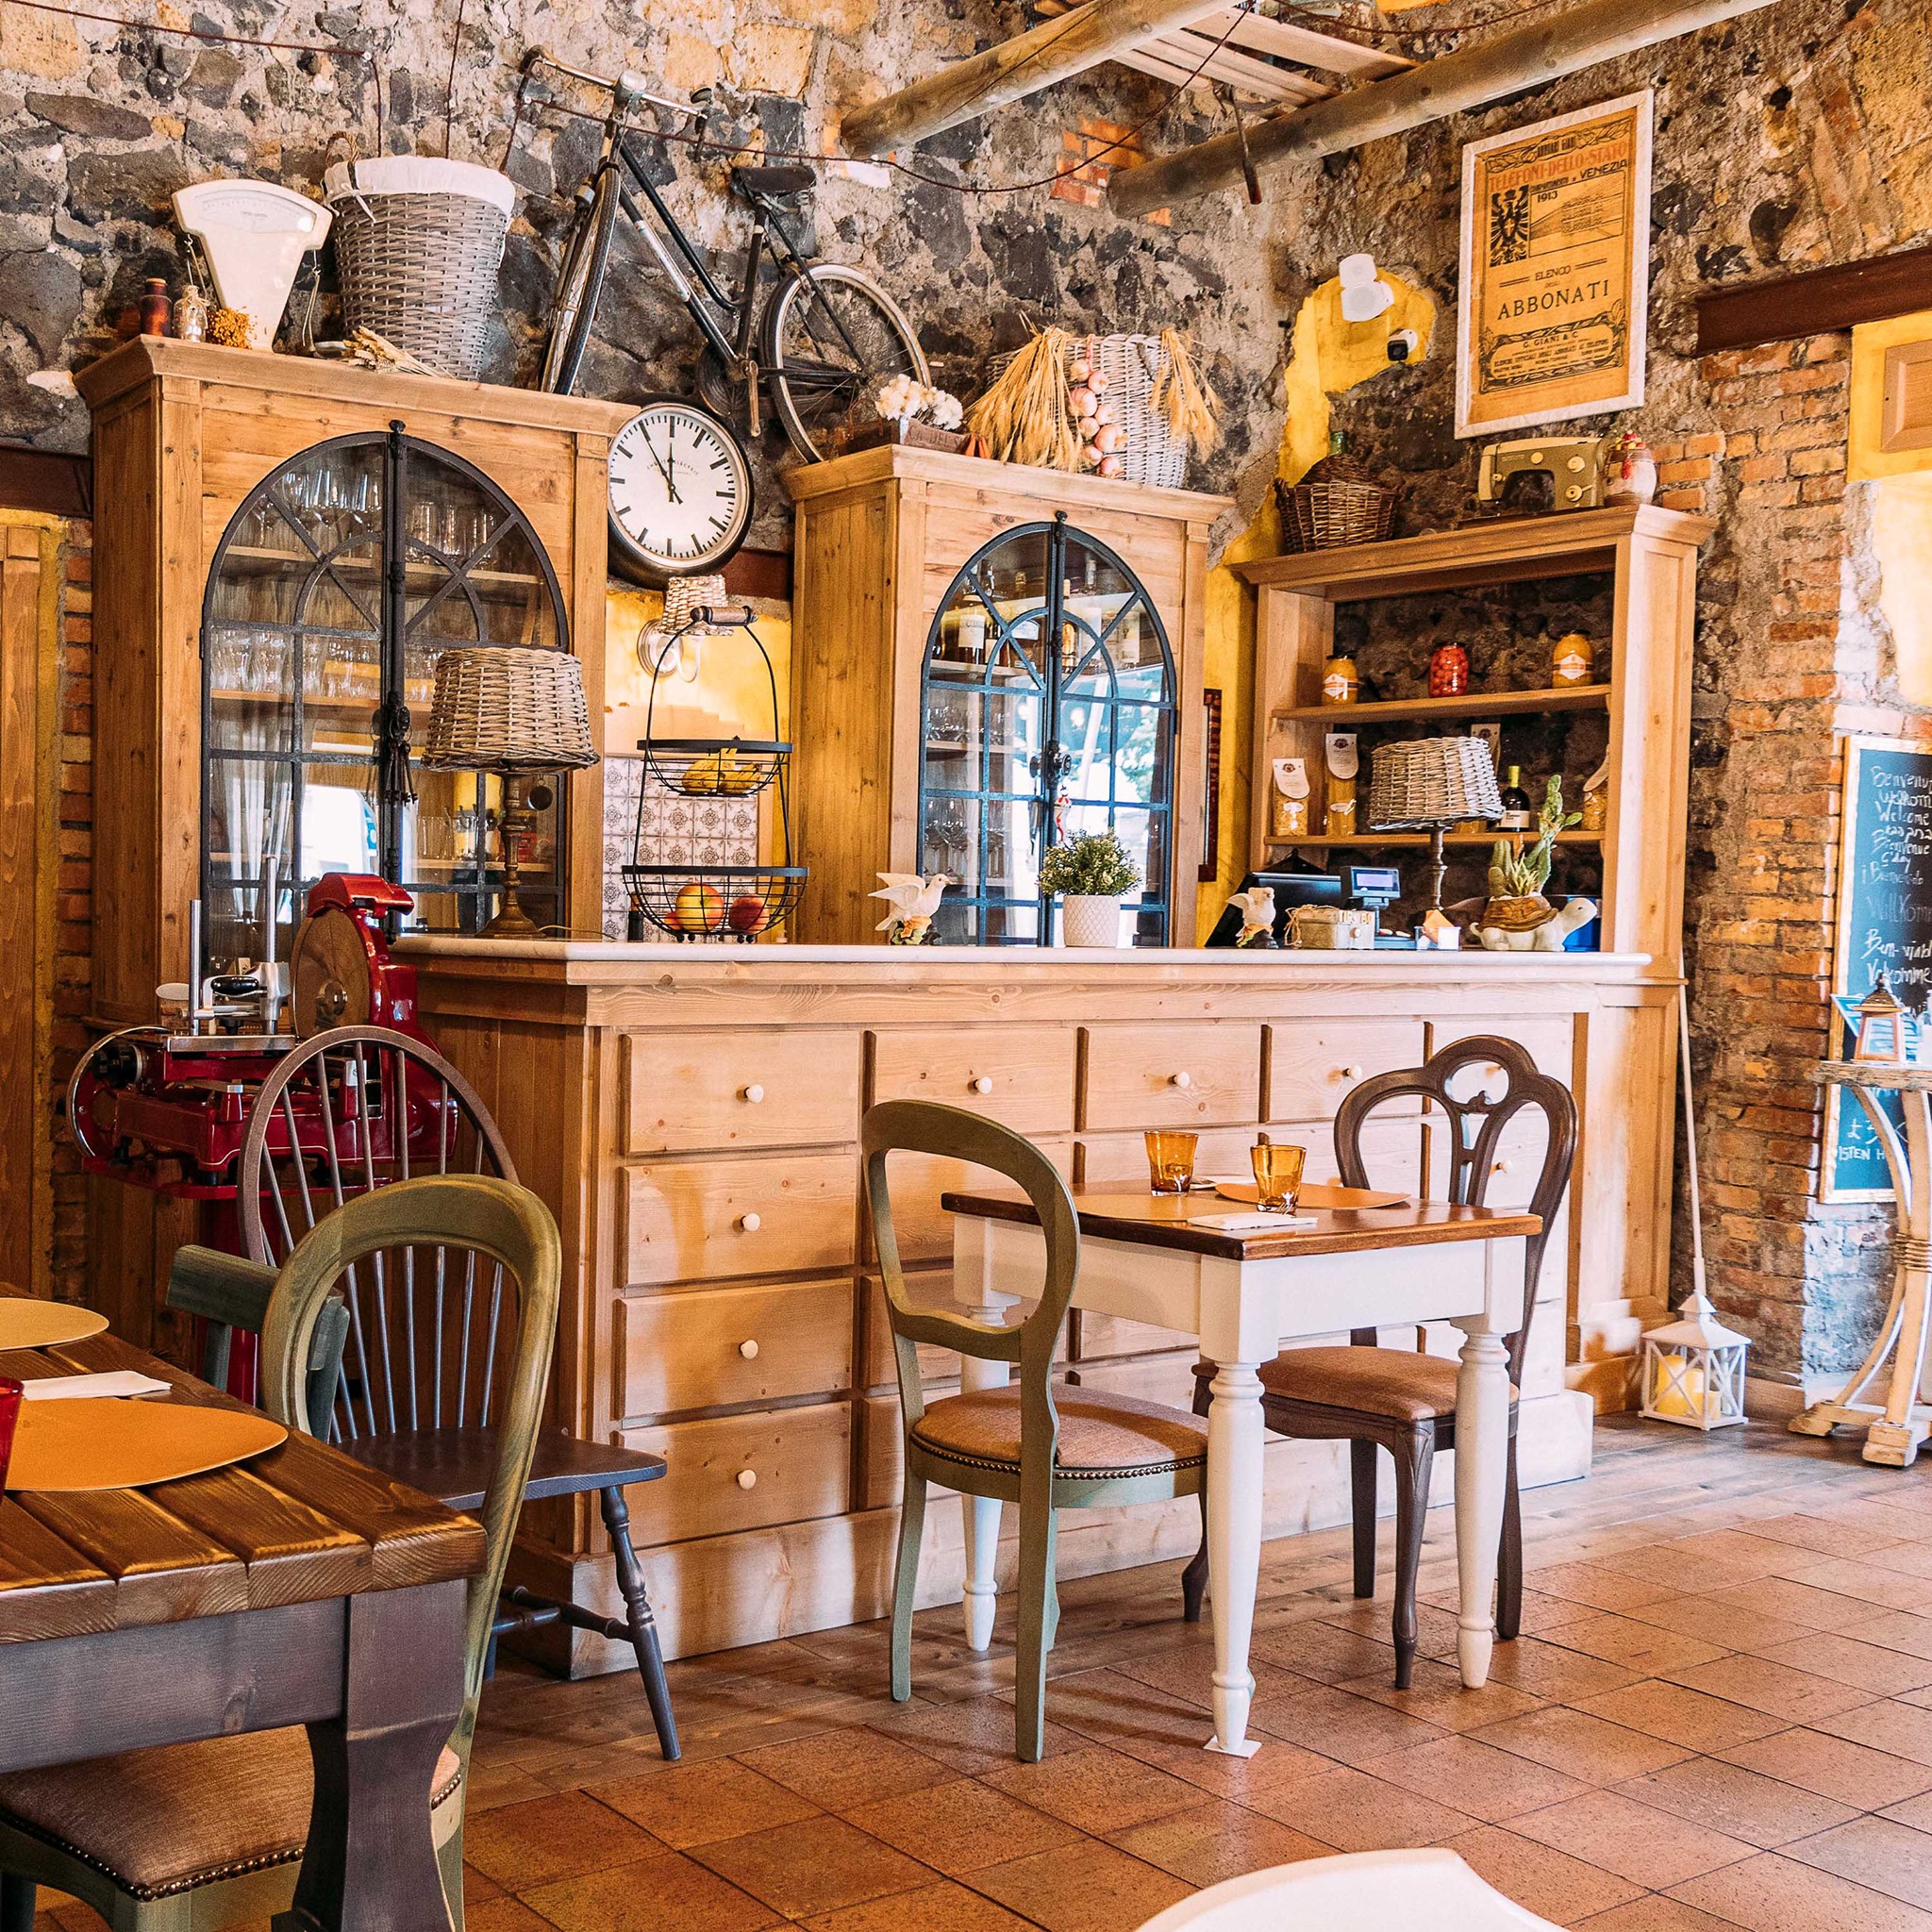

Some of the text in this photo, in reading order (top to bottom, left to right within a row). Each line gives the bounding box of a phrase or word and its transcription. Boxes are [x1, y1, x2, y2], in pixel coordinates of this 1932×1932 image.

[1488, 165, 1544, 193] TELEFONI
[1590, 142, 1627, 164] STATO
[1580, 158, 1628, 179] VENEZIA
[1497, 279, 1608, 320] ABBONATI
